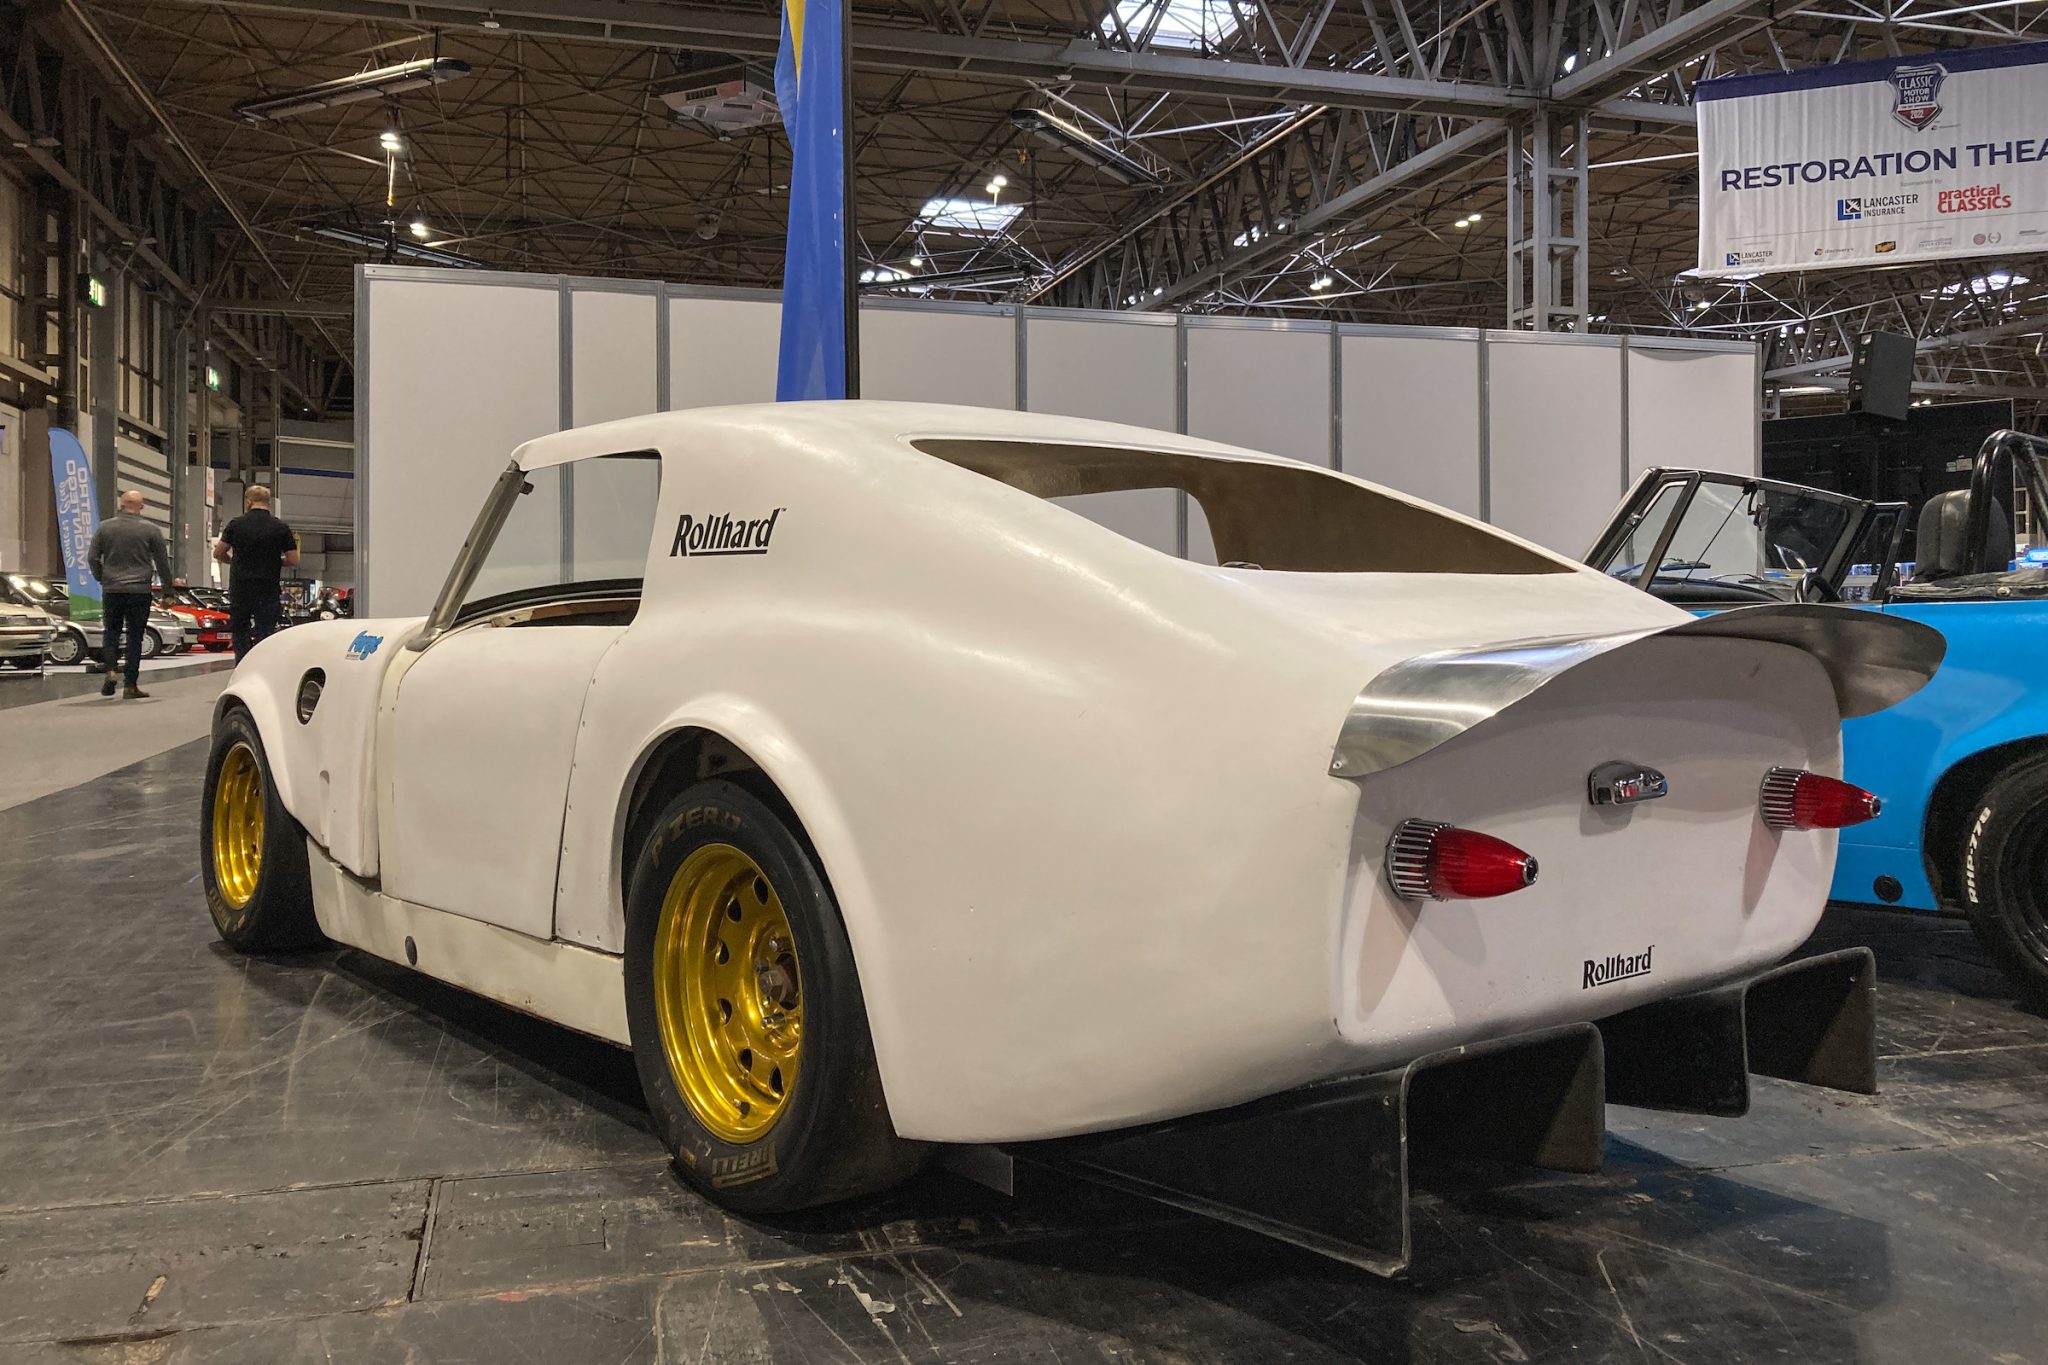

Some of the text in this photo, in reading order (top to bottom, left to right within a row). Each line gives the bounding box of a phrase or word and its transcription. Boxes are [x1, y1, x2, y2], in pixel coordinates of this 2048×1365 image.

[1899, 75, 1934, 90] CLASSIC
[1904, 88, 1930, 97] MOTOR
[1904, 95, 1930, 104] SHOW
[1910, 109, 1925, 119] 2022
[1721, 146, 1957, 191] RESTORATION
[1938, 184, 2000, 200] practical
[1863, 194, 1919, 208] LANCASTER
[1937, 195, 2012, 214] CLASSICS
[1864, 206, 1906, 217] INSURANCE
[1741, 250, 1773, 259] LANCASTER
[669, 508, 780, 557] Rollhard
[669, 806, 742, 842] ZERO
[1582, 945, 1652, 990] Rollhard
